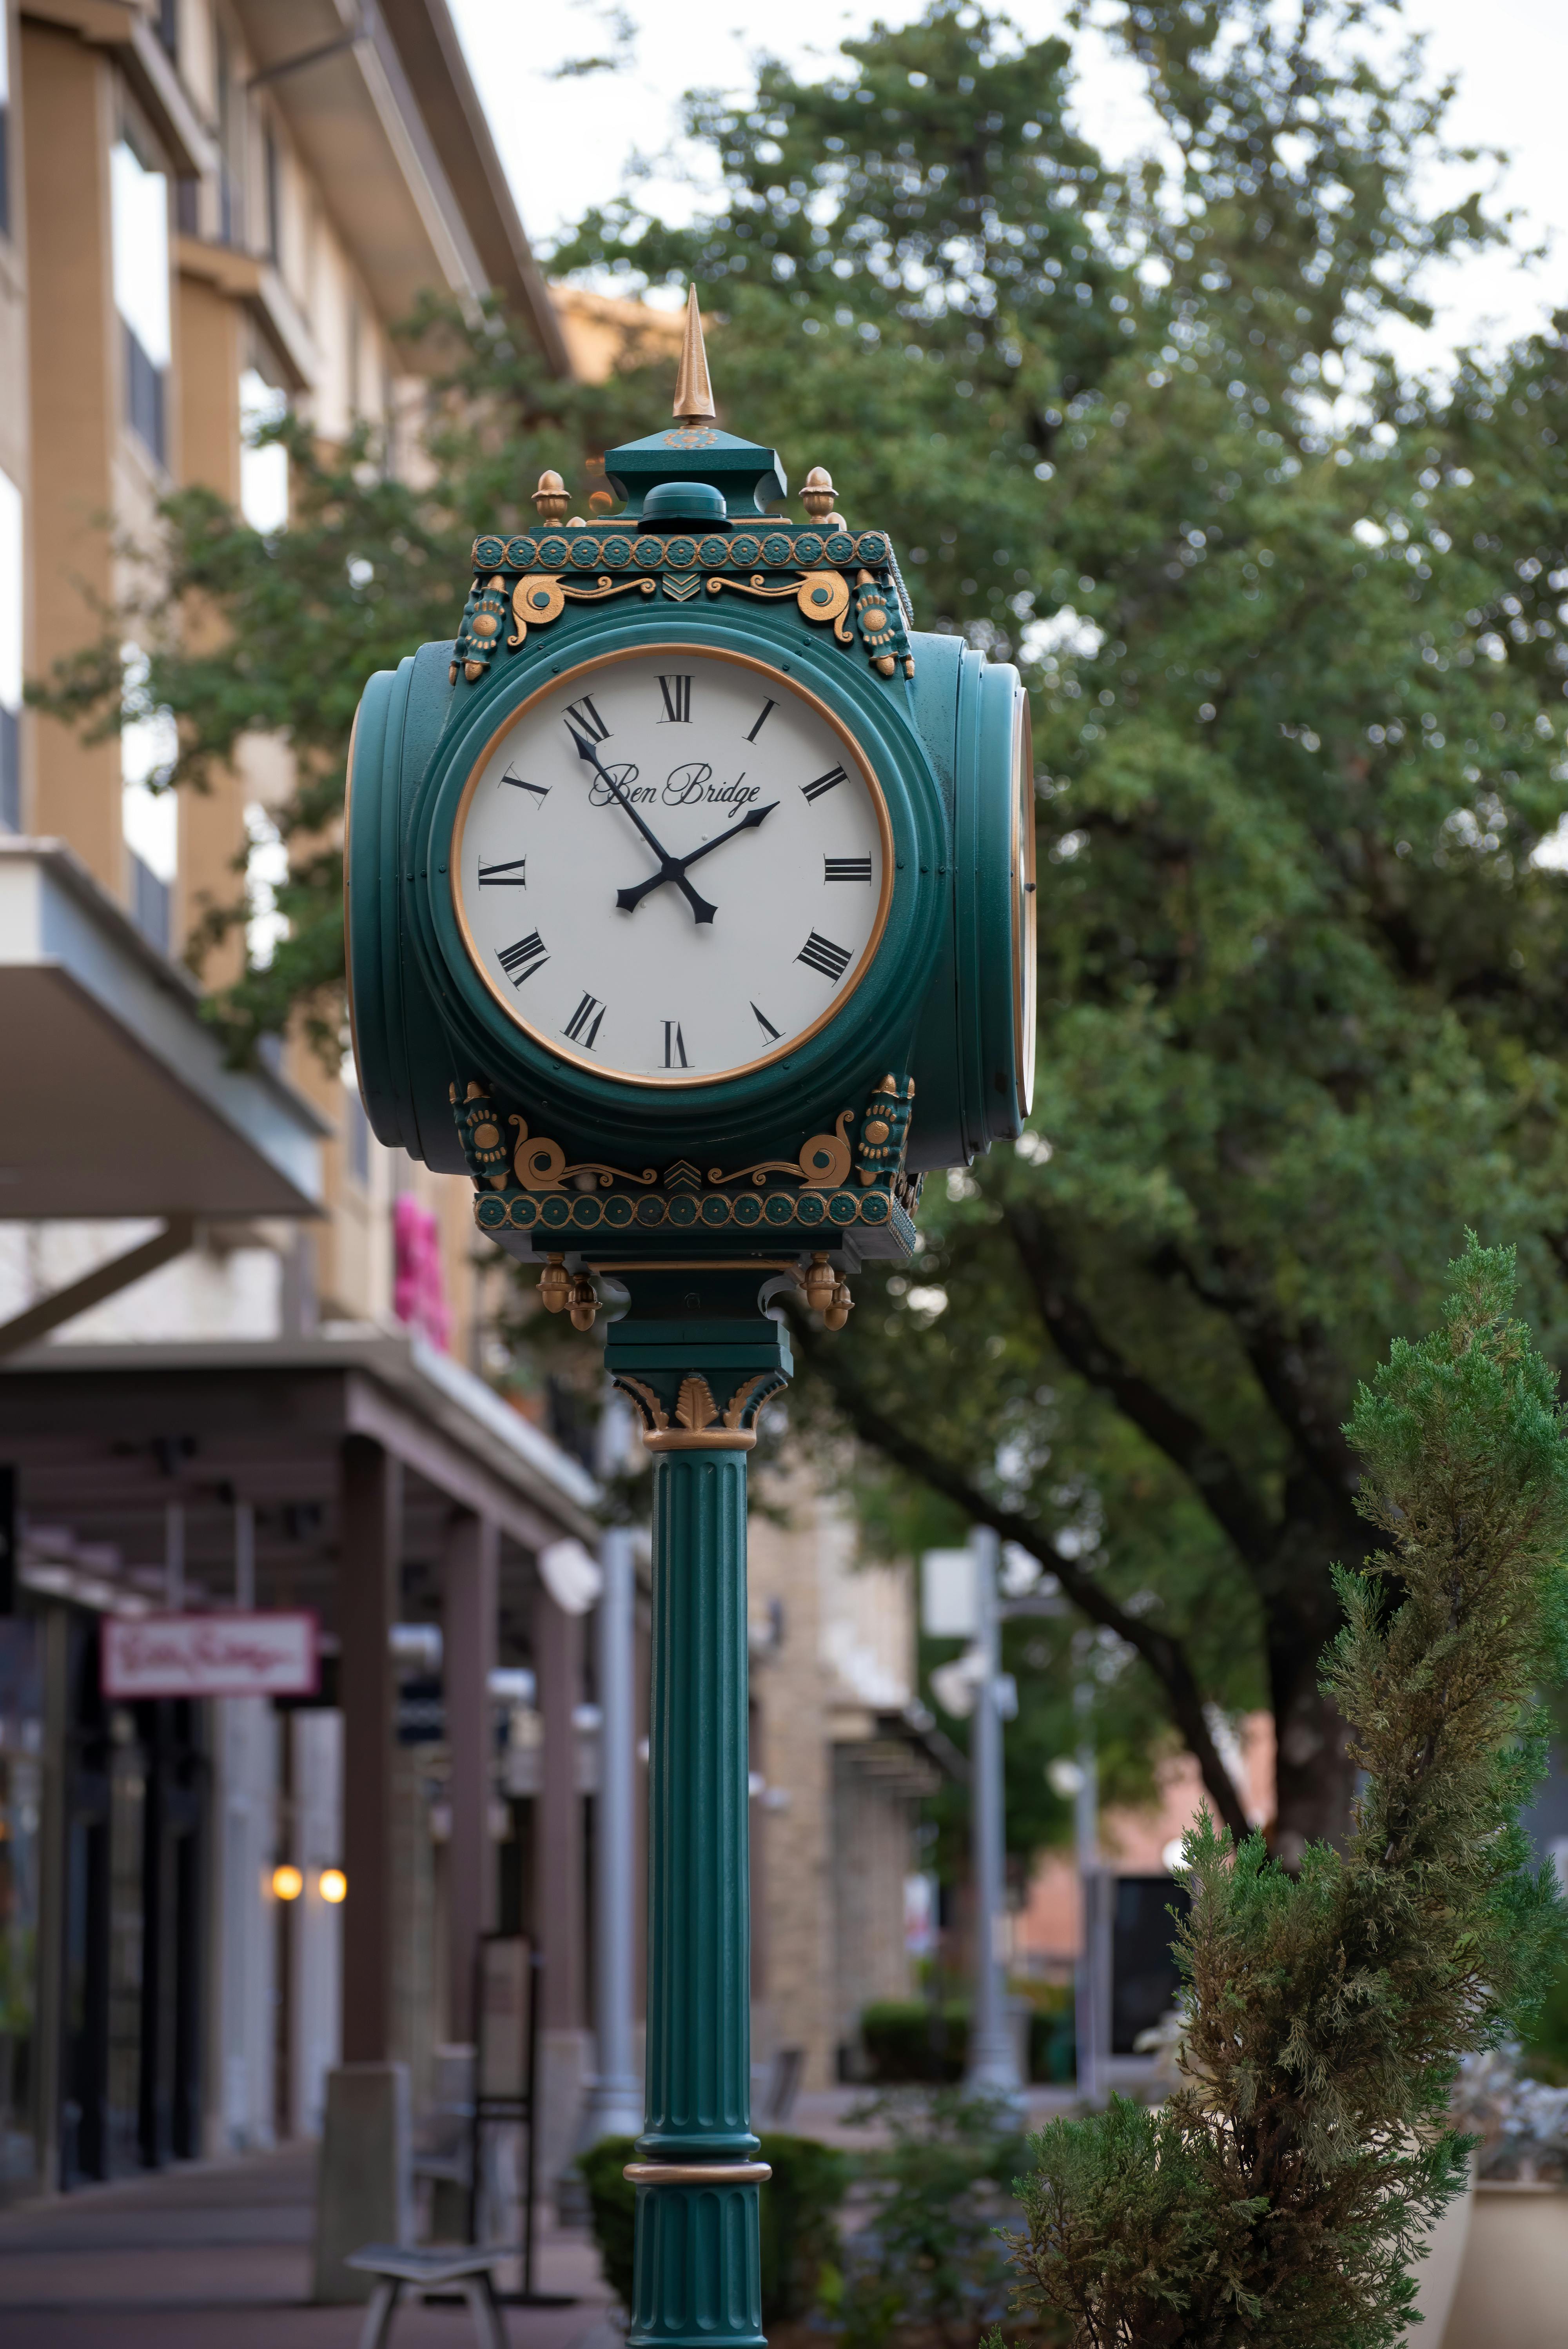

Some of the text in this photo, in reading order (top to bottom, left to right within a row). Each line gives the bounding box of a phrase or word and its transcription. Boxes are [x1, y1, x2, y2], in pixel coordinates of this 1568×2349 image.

[653, 675, 695, 723] XII
[742, 696, 780, 745] I
[497, 761, 552, 810] X
[588, 762, 760, 819] Ben Bridge
[798, 761, 851, 806] II
[824, 851, 871, 886] III
[792, 926, 855, 988] IIII
[657, 1020, 695, 1069] VI
[750, 1001, 786, 1047] V
